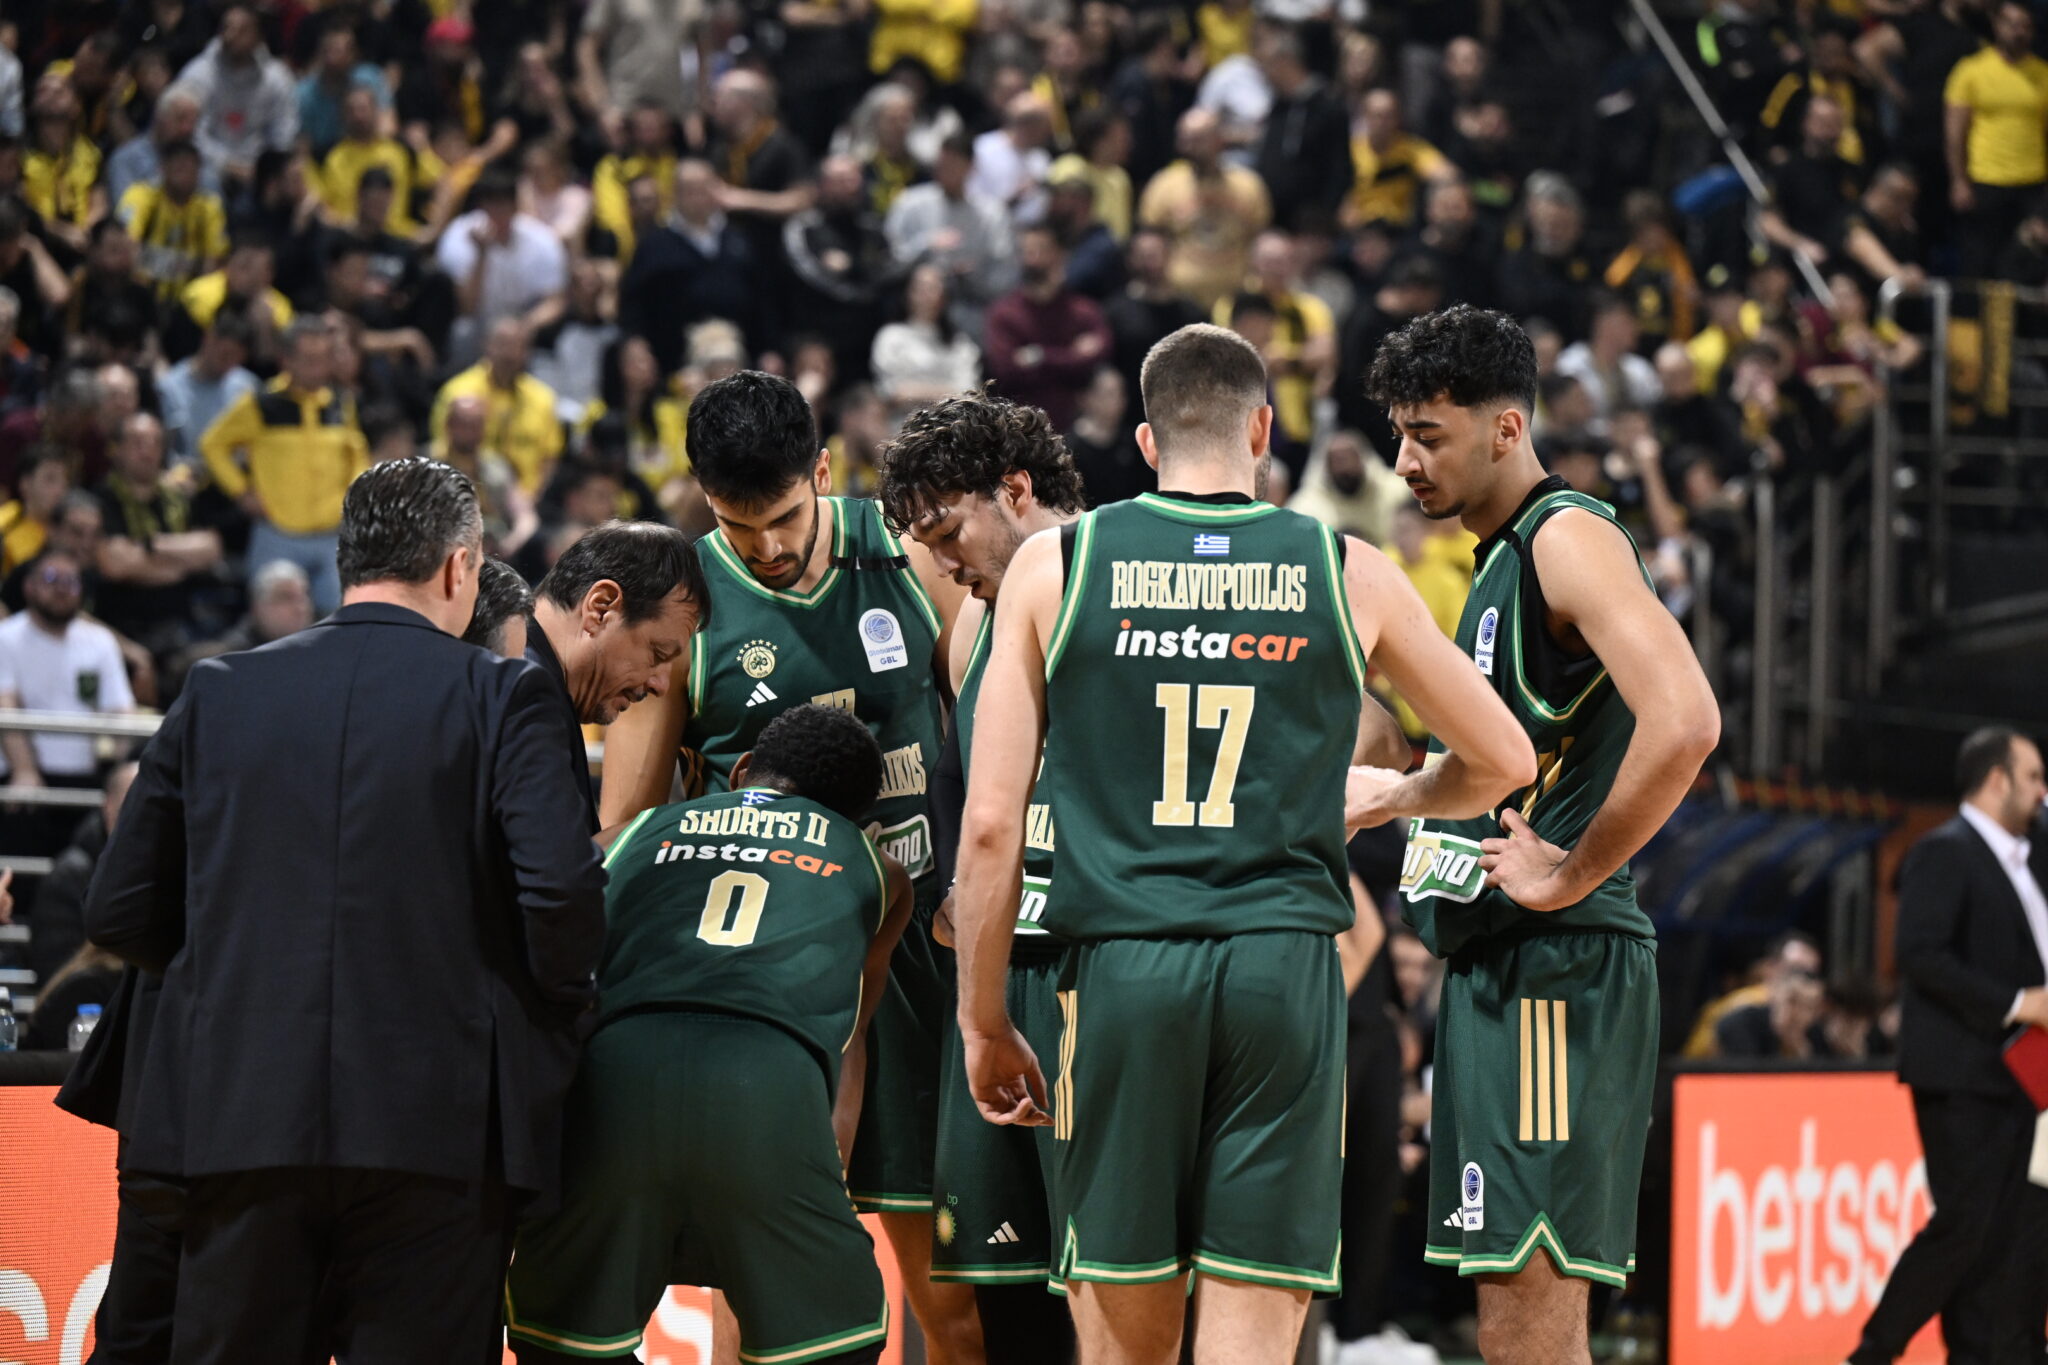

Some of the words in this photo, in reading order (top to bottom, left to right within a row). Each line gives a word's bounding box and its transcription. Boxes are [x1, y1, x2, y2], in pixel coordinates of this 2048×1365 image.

[1110, 560, 1307, 612] ROGKAVOPOULOS
[880, 656, 898, 665] GBL
[1115, 618, 1308, 662] instacar
[1152, 683, 1255, 827] 17
[679, 807, 801, 839] SHORTS
[804, 812, 830, 847] II
[654, 840, 843, 877] instacar
[696, 869, 770, 947] 0
[947, 1192, 958, 1206] bp
[1697, 1118, 1930, 1330] betss
